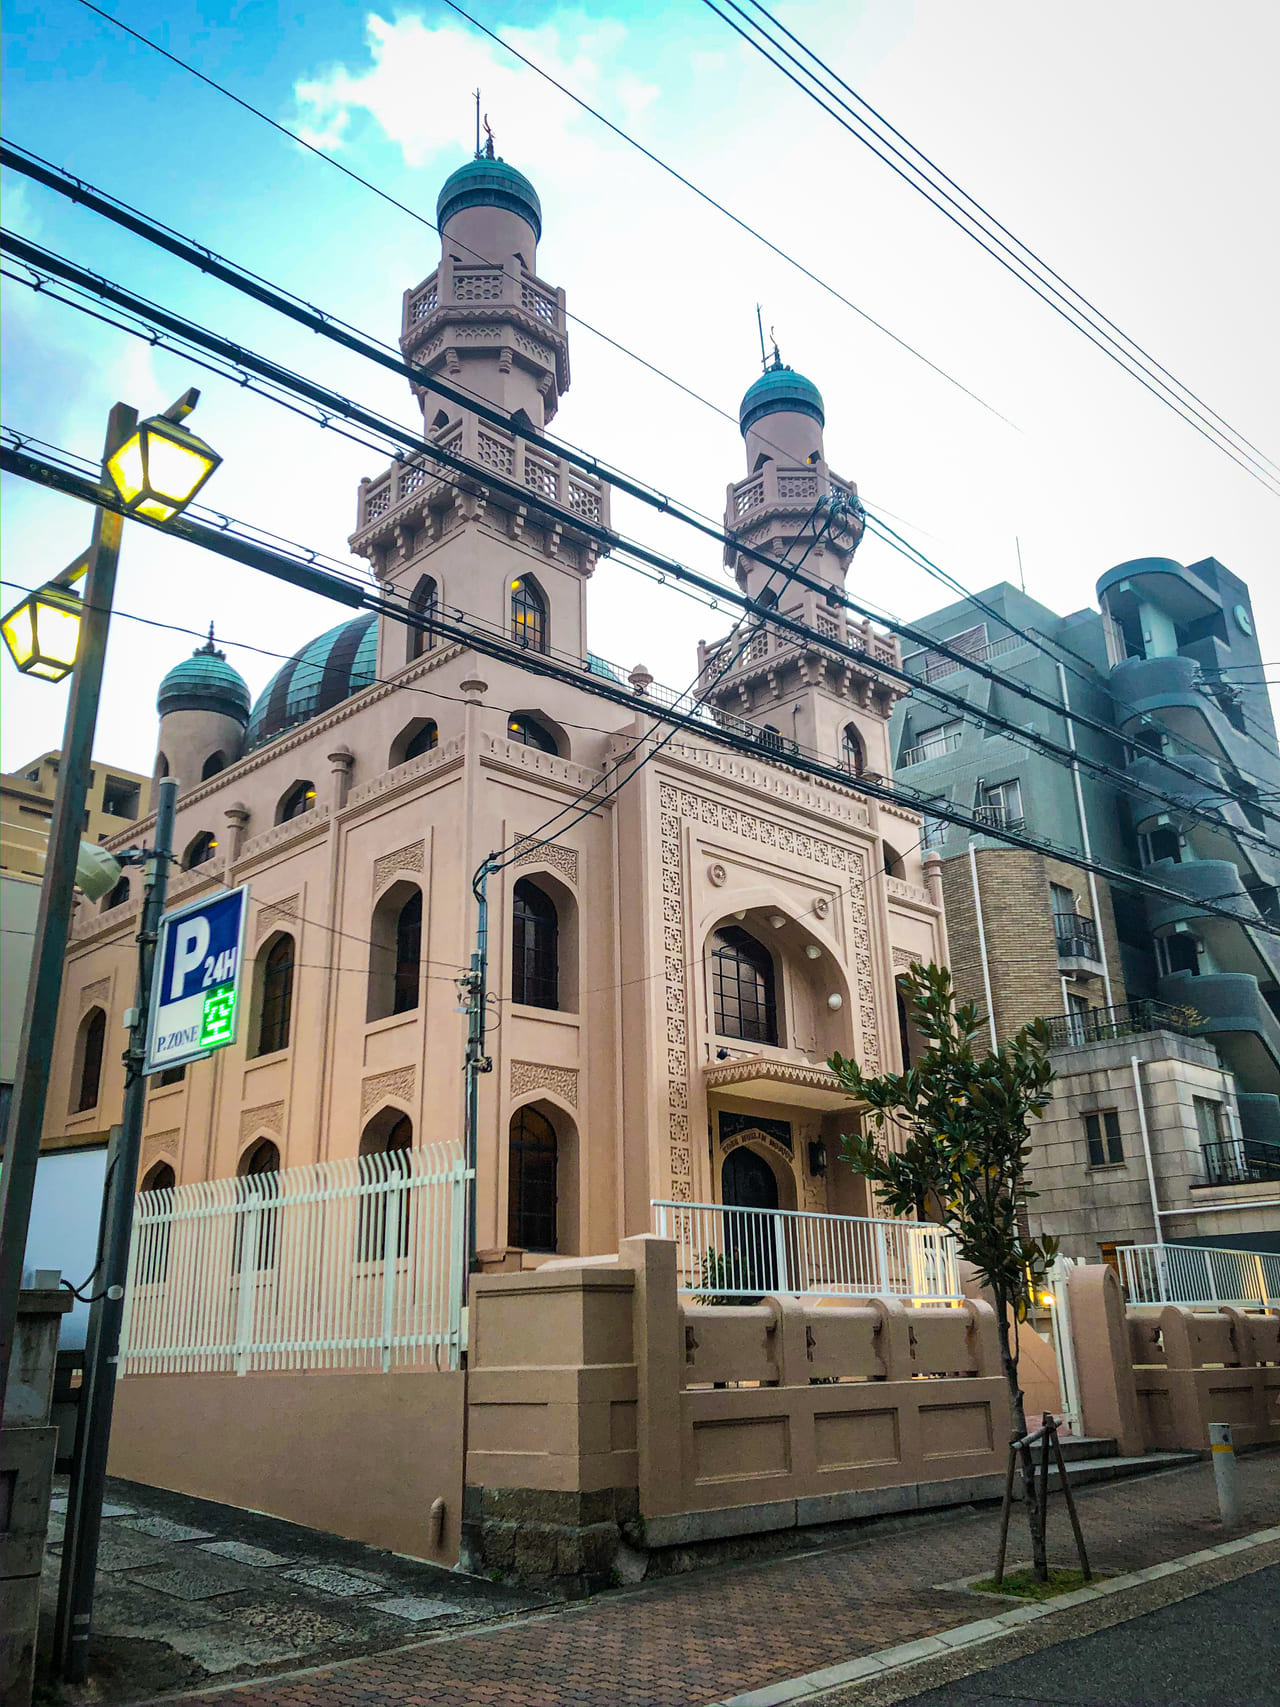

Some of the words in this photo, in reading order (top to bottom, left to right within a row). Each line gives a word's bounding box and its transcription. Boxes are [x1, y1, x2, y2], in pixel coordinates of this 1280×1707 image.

[171, 916, 210, 999] P
[202, 947, 236, 987] 24H
[157, 1025, 199, 1053] P.ZONE
[200, 988, 236, 1046] 空
